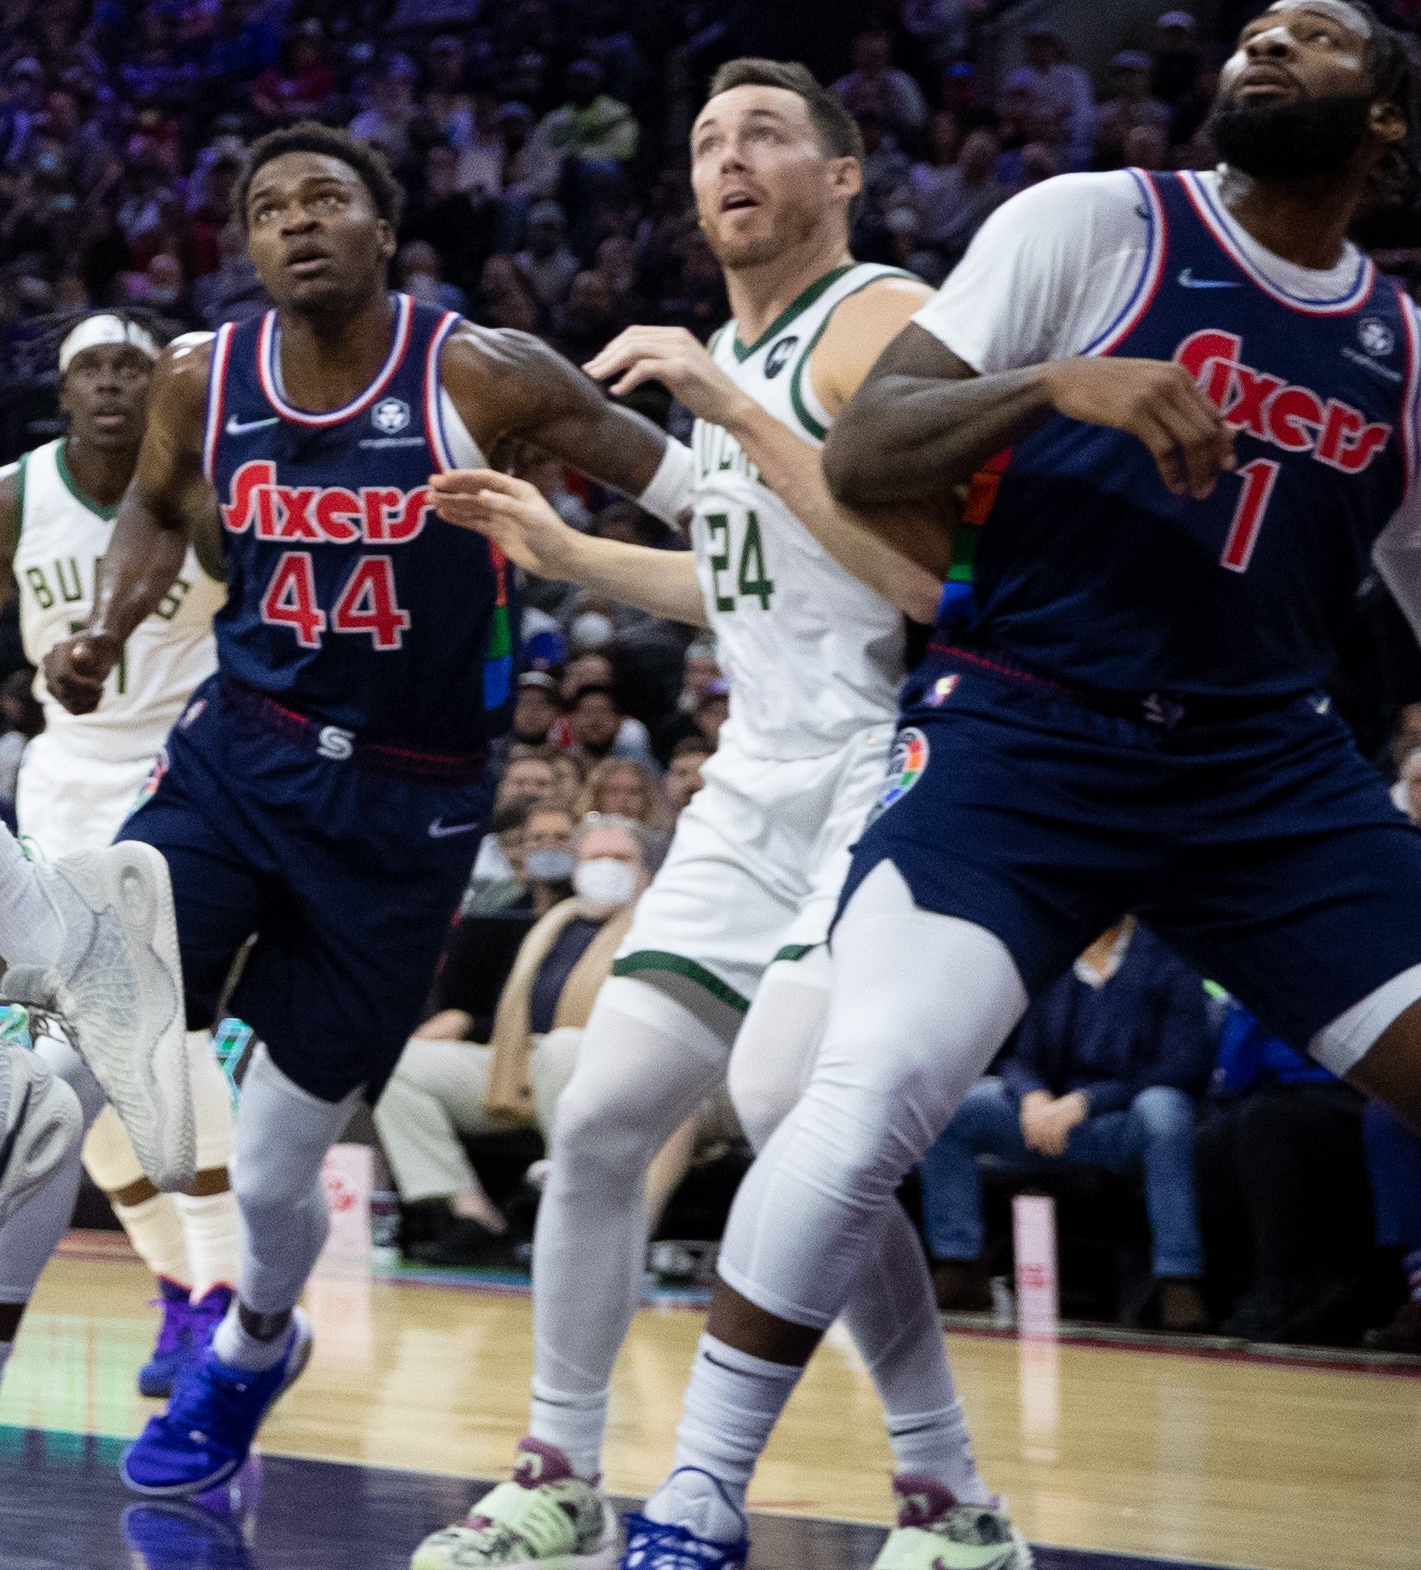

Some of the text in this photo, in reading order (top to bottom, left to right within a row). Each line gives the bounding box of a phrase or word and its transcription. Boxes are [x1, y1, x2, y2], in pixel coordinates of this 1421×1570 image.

[1171, 327, 1393, 475] Sixers
[219, 458, 437, 546] Sixers
[1218, 456, 1282, 575] 1
[24, 556, 192, 622] BUS
[259, 550, 412, 653] 44
[704, 510, 774, 613] 24
